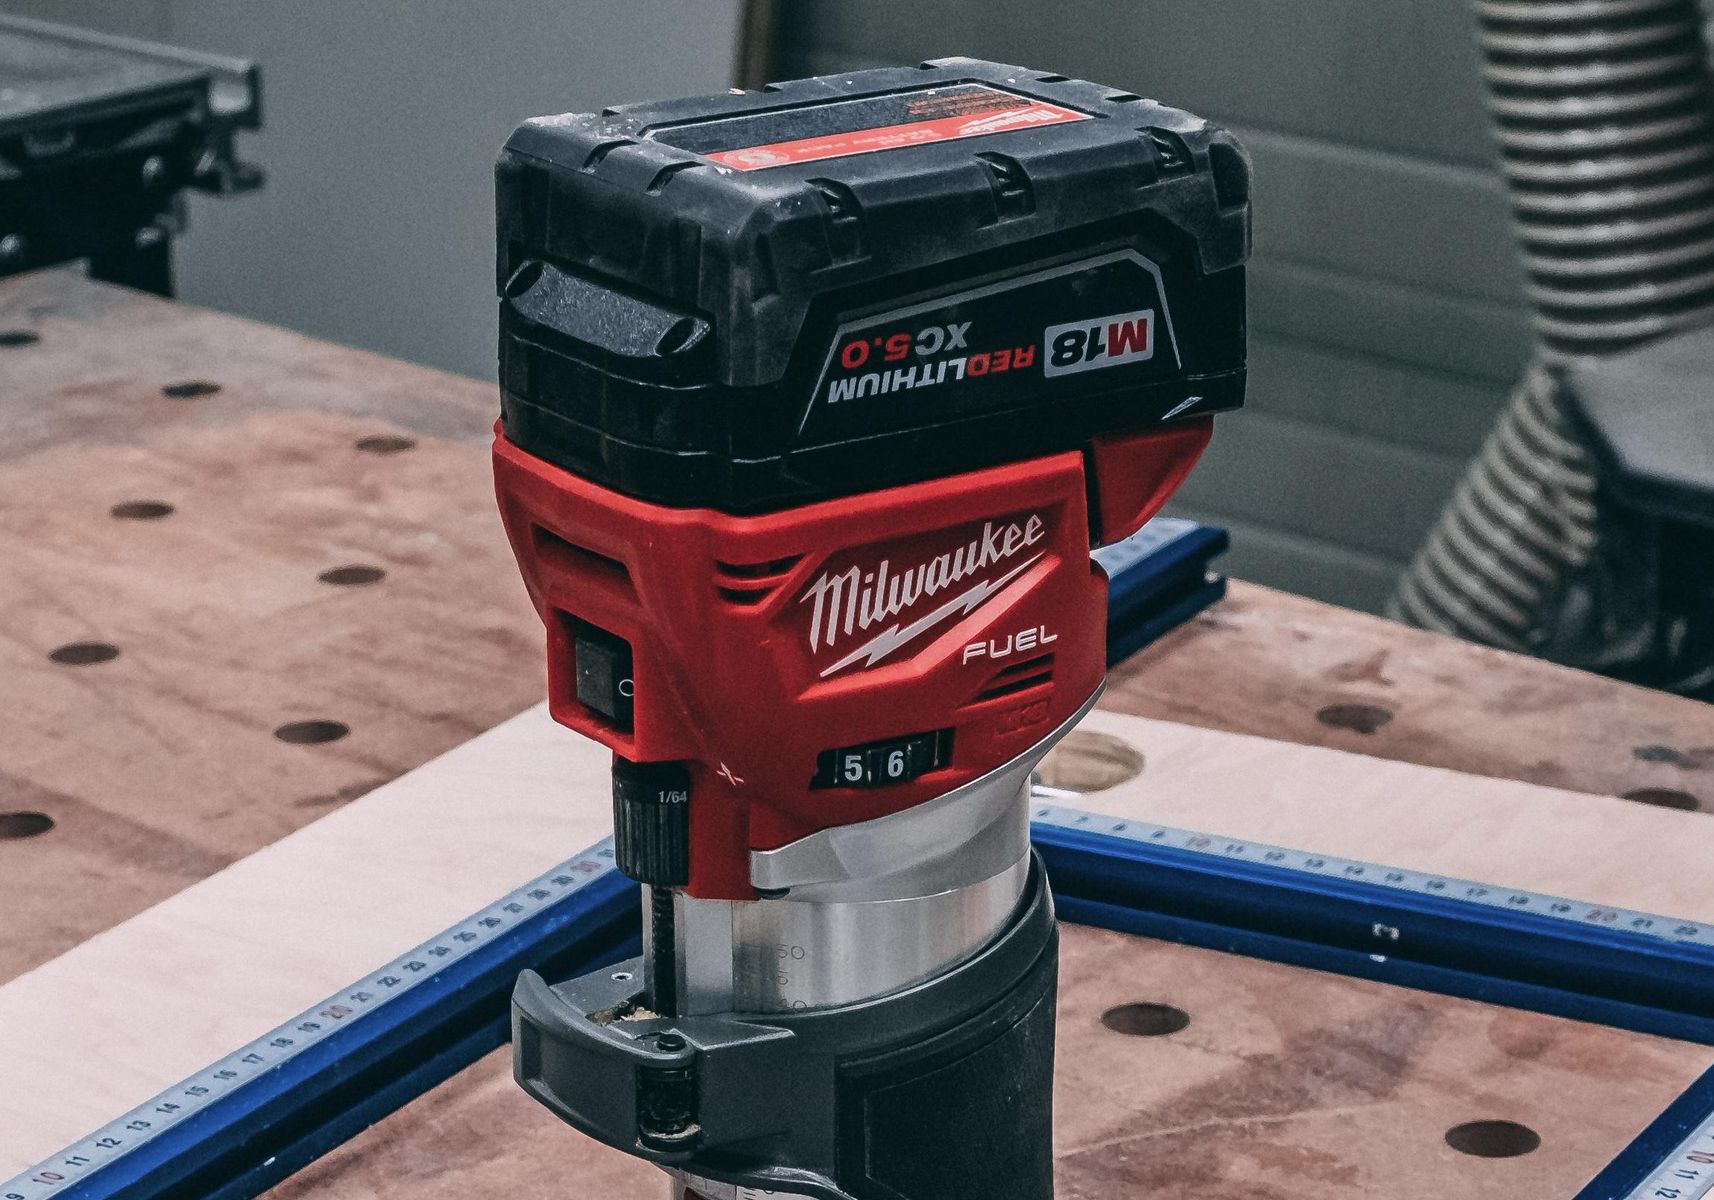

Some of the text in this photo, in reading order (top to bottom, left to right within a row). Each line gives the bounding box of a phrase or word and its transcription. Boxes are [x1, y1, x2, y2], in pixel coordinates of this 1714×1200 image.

[827, 317, 1149, 403] M18 REDLITHIUM
[800, 514, 1046, 655] Milwaukee
[961, 625, 1059, 666] FUEL
[843, 750, 905, 782] 5 6
[657, 790, 688, 804] 1/64
[32, 1170, 66, 1186] 10
[65, 1154, 91, 1168] 11
[96, 1136, 123, 1151] 12
[126, 1119, 152, 1133] 13
[155, 1102, 182, 1115] 14
[184, 1085, 210, 1098] 15
[213, 1069, 239, 1082] 16
[241, 1052, 265, 1066] 17
[1675, 1168, 1700, 1181] 11
[1655, 1187, 1682, 1200] 12
